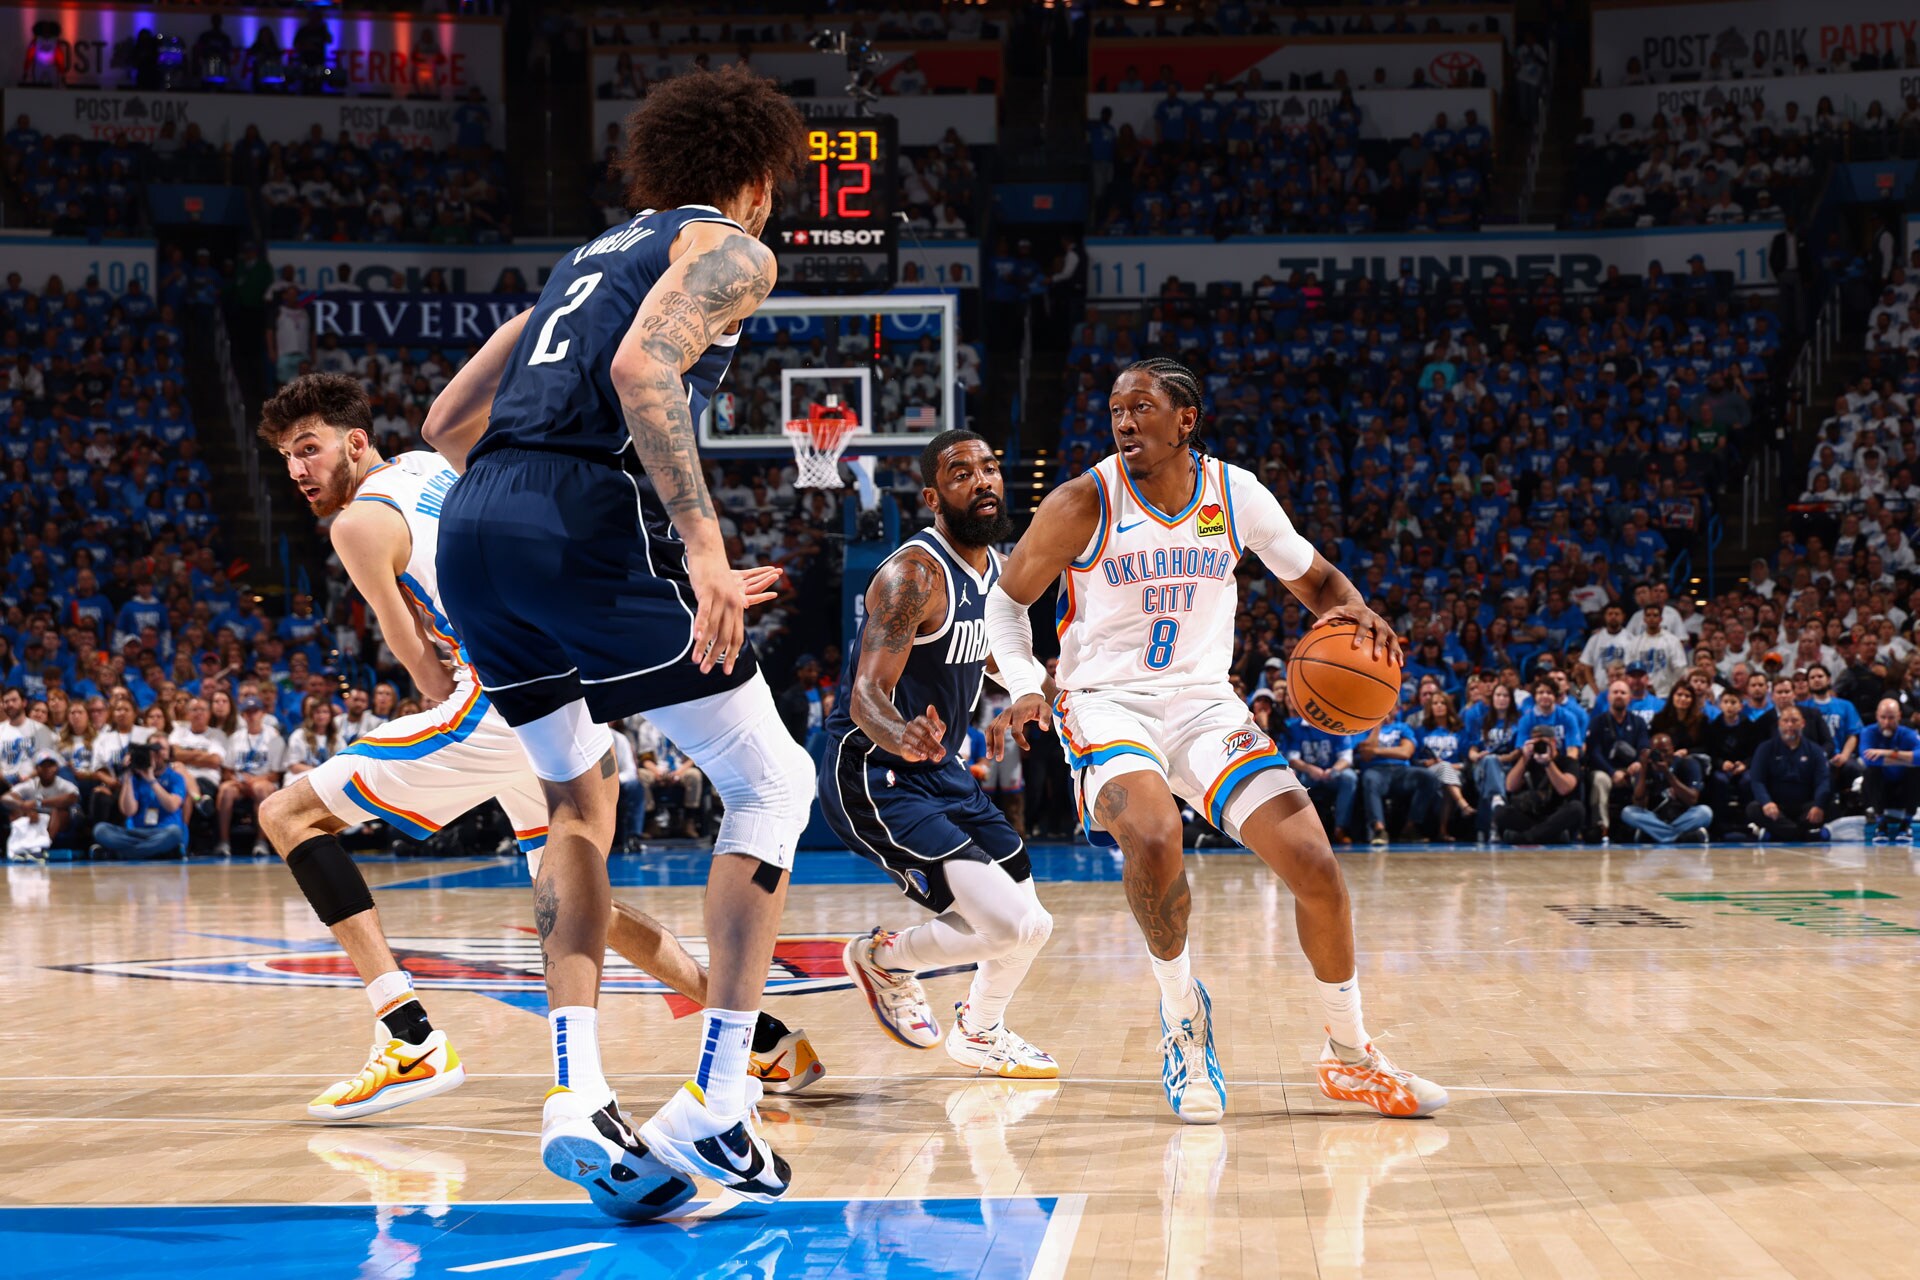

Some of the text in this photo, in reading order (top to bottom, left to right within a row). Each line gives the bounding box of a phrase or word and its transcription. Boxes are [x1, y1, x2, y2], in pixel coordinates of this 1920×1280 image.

[1644, 34, 1710, 70] POST
[1754, 28, 1808, 63] OAK
[75, 99, 189, 122] POST OAK
[1658, 89, 1701, 113] POST
[91, 124, 160, 142] TOYOT
[340, 106, 450, 131] POST OAK
[808, 130, 879, 162] 9:37
[819, 162, 872, 218] 12
[809, 229, 885, 245] TISSOT
[1092, 262, 1147, 295] 111
[1279, 254, 1603, 294] THUNDER
[1736, 247, 1768, 281] 11
[527, 271, 603, 366] 2
[1101, 546, 1232, 587] OKLAHOMA
[1142, 582, 1198, 615] CITY
[1144, 616, 1180, 672] 8
